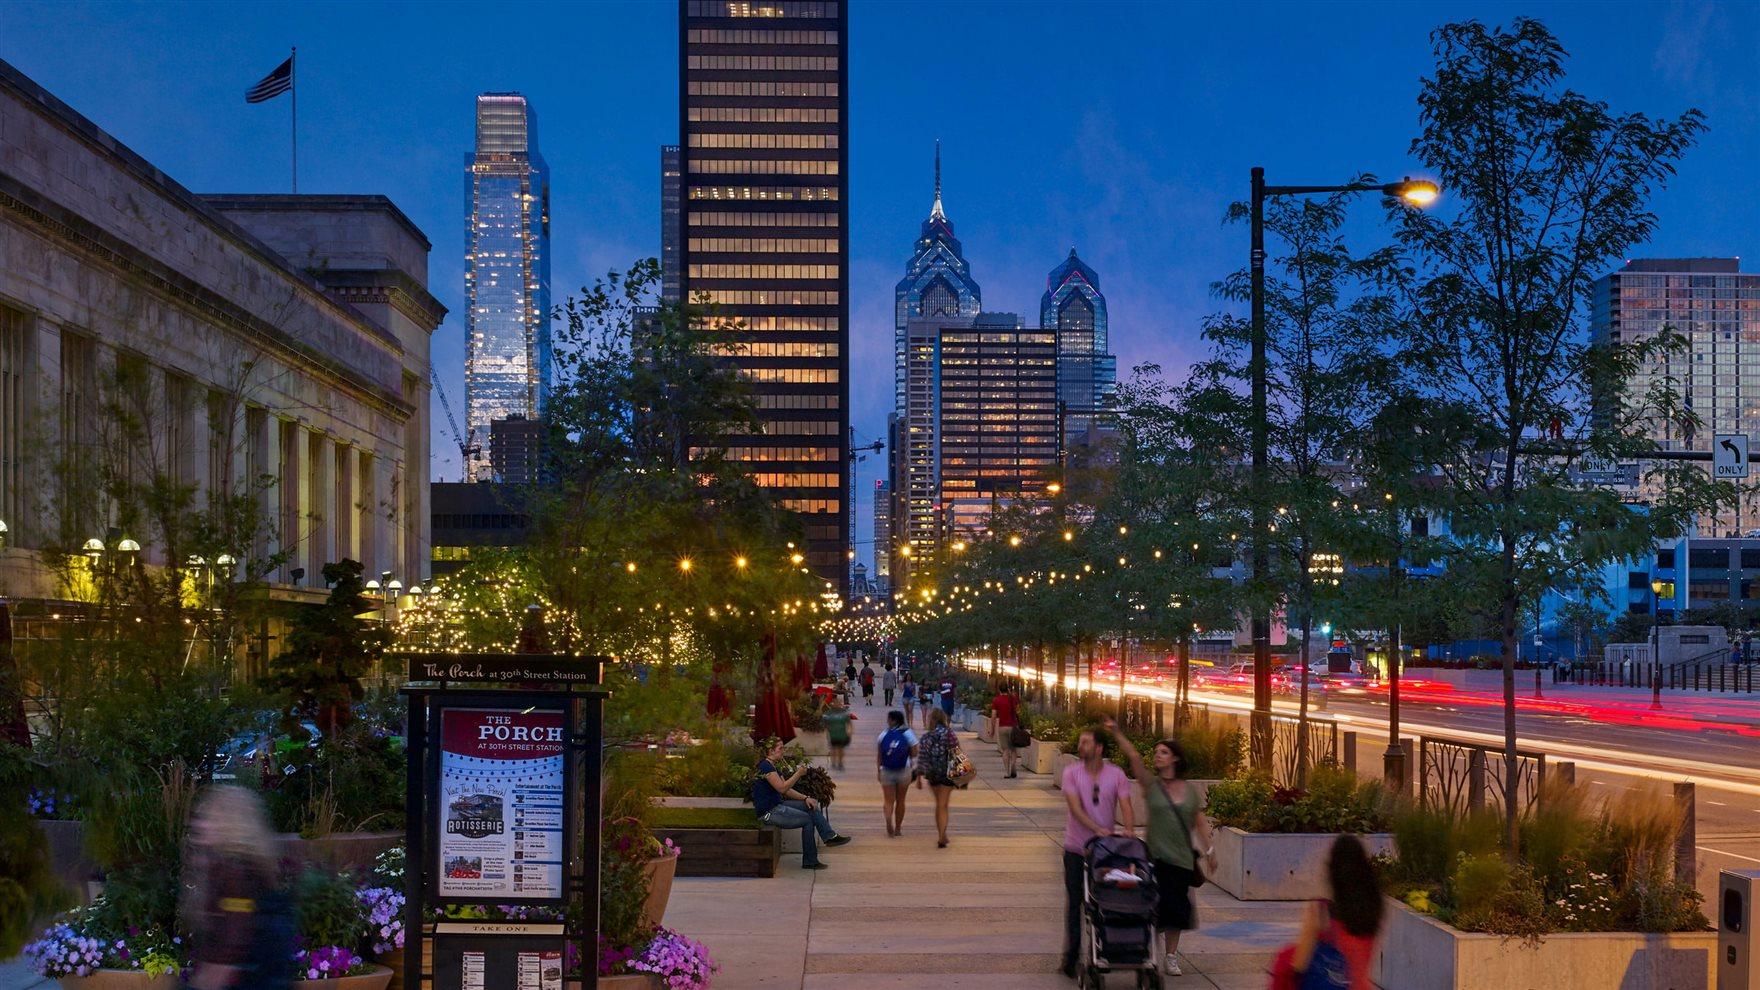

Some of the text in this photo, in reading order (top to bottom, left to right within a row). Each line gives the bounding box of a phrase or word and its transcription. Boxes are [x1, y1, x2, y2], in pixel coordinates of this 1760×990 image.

[1587, 461, 1611, 471] ONLY
[1718, 465, 1744, 475] ONLY
[423, 663, 446, 678] The
[449, 663, 486, 678] Porch
[500, 669, 521, 680] 30th
[523, 670, 551, 680] Street
[553, 670, 587, 680] Station
[486, 715, 511, 724] THE
[478, 725, 564, 742] PORCH
[508, 743, 534, 751] STREET
[448, 820, 503, 834] ROTISSERIE
